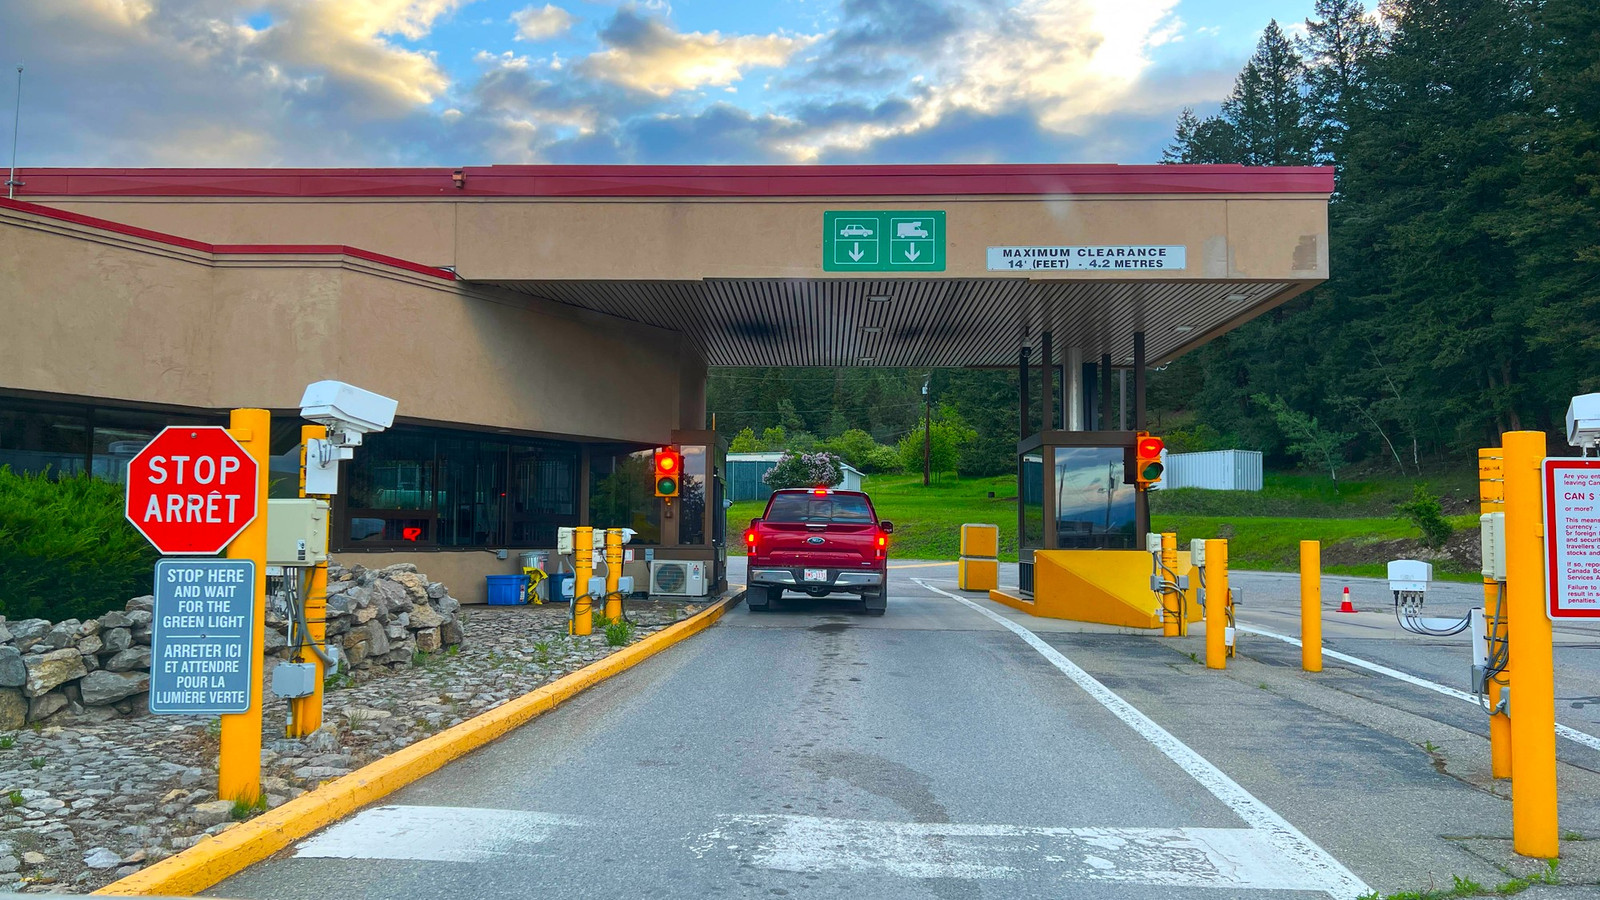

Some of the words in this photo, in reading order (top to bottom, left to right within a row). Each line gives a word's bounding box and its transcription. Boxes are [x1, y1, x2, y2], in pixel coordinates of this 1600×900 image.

[1003, 249, 1070, 257] MAXIMUM
[1077, 248, 1167, 257] CLEARANCE
[1008, 260, 1027, 268] 14'
[1032, 259, 1069, 269] (FEET)
[1089, 259, 1110, 268] 4.2
[1114, 259, 1163, 268] METRES
[148, 455, 240, 485] STOP
[1564, 492, 1585, 500] CAN
[143, 490, 241, 523] ARRÊT
[167, 569, 204, 582] STOP
[208, 569, 244, 582] HERE
[174, 586, 200, 598] AND
[204, 586, 236, 598] WAIT
[178, 600, 204, 613] FOR
[206, 600, 231, 613] THE
[163, 615, 204, 628] GREEN
[208, 615, 245, 628] LIGHT
[164, 644, 222, 658] ARRETER
[225, 644, 241, 658] ICI
[165, 661, 178, 673] ET
[181, 660, 239, 673] ATTENDRE
[176, 676, 208, 688] POUR
[211, 676, 225, 688] LA
[156, 689, 206, 704] LUMIÈRE
[209, 691, 245, 703] VERTE
